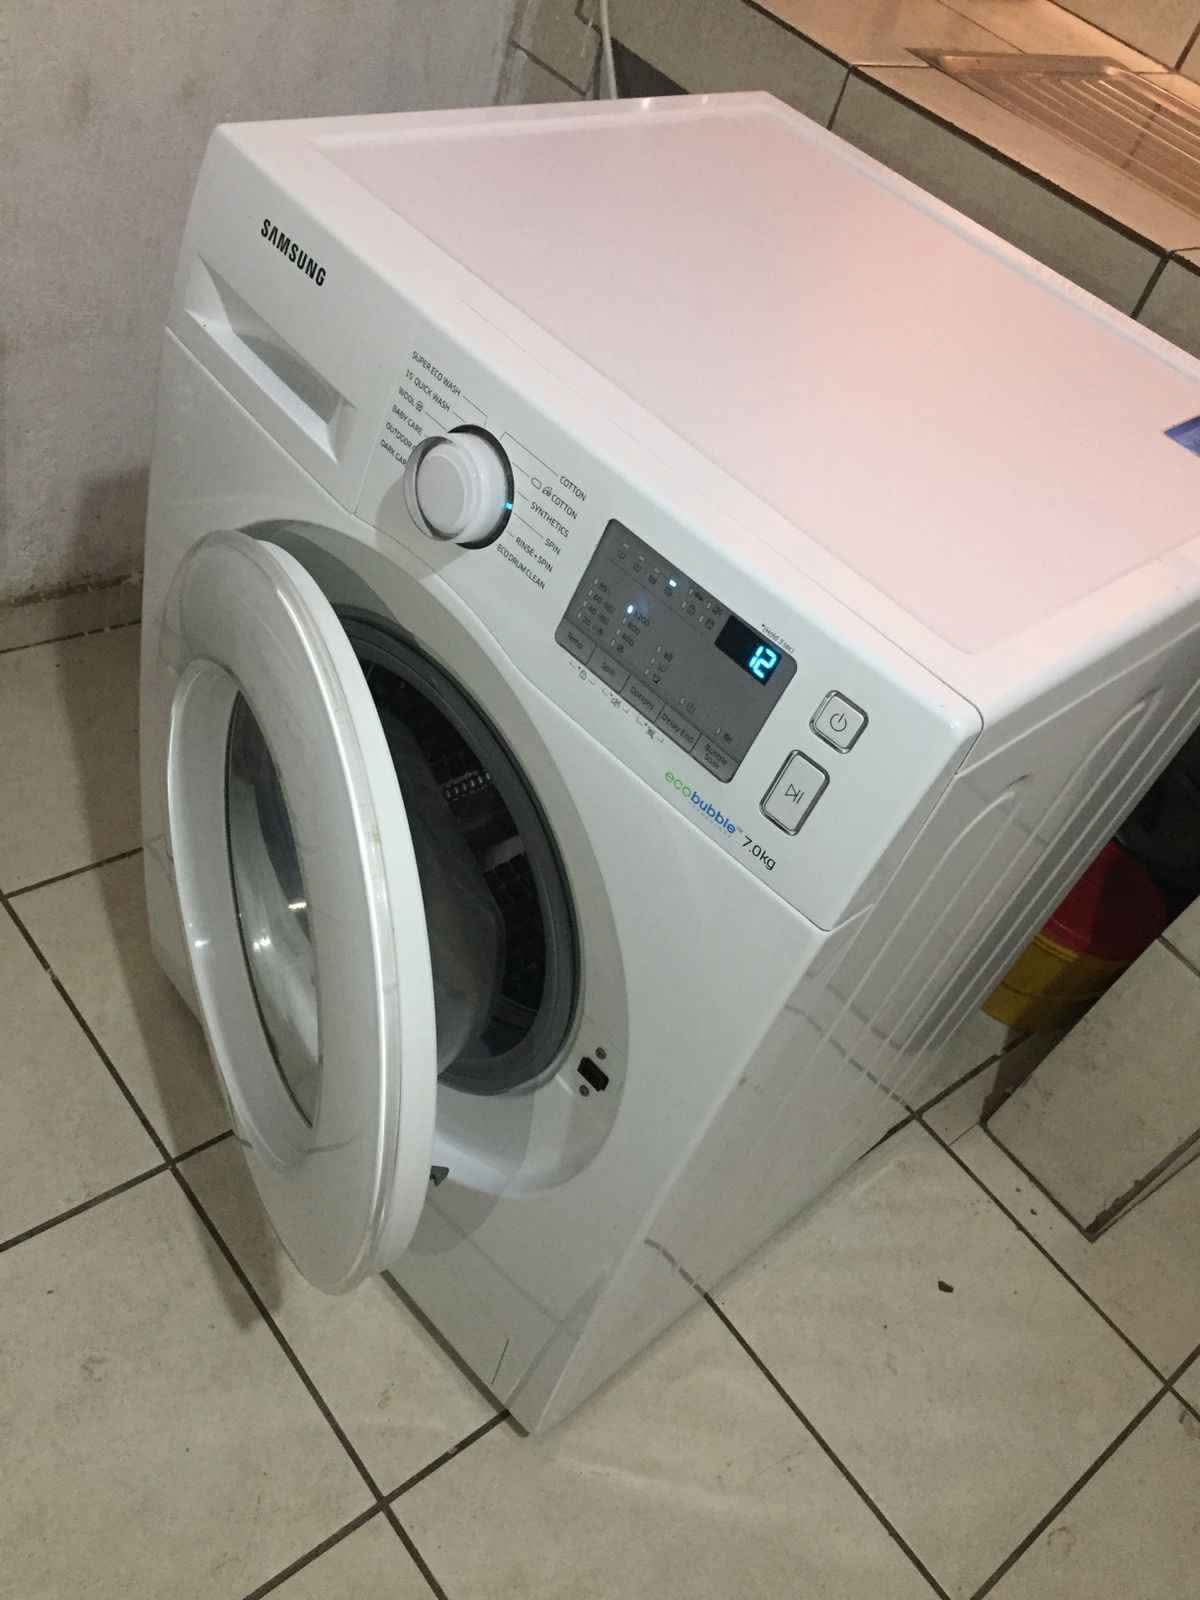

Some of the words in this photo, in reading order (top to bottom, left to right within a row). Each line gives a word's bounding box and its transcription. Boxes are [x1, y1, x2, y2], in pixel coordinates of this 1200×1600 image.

[261, 218, 326, 286] SAMSUNG
[443, 376, 461, 396] WASH
[433, 392, 451, 412] WASH
[560, 476, 587, 501] COTTON
[530, 501, 569, 538] SYNTHETICS
[551, 495, 577, 519] COTTON
[544, 538, 561, 555] SPIN
[749, 645, 777, 679] 12
[742, 835, 776, 871] 7.0kg
